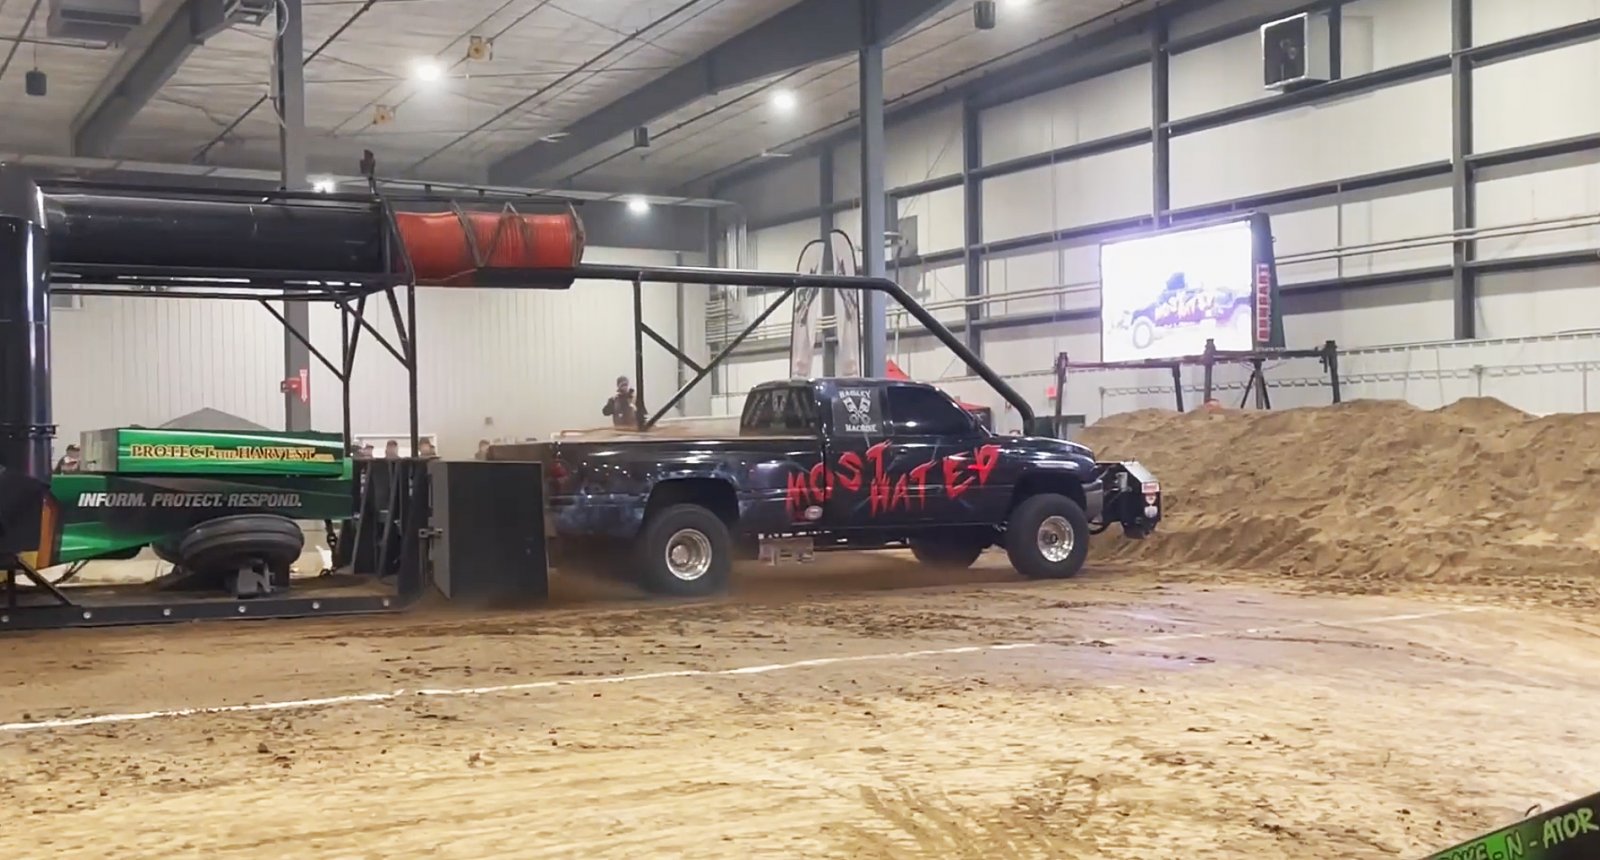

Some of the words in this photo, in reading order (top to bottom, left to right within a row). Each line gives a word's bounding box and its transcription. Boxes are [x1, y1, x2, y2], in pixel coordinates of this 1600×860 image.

[131, 444, 214, 459] PROTECT
[784, 438, 894, 521] MOST
[869, 444, 1002, 518] HATED
[78, 493, 146, 507] INFORM.
[151, 493, 223, 507] PROTECT.
[228, 493, 302, 508] RESPOND.
